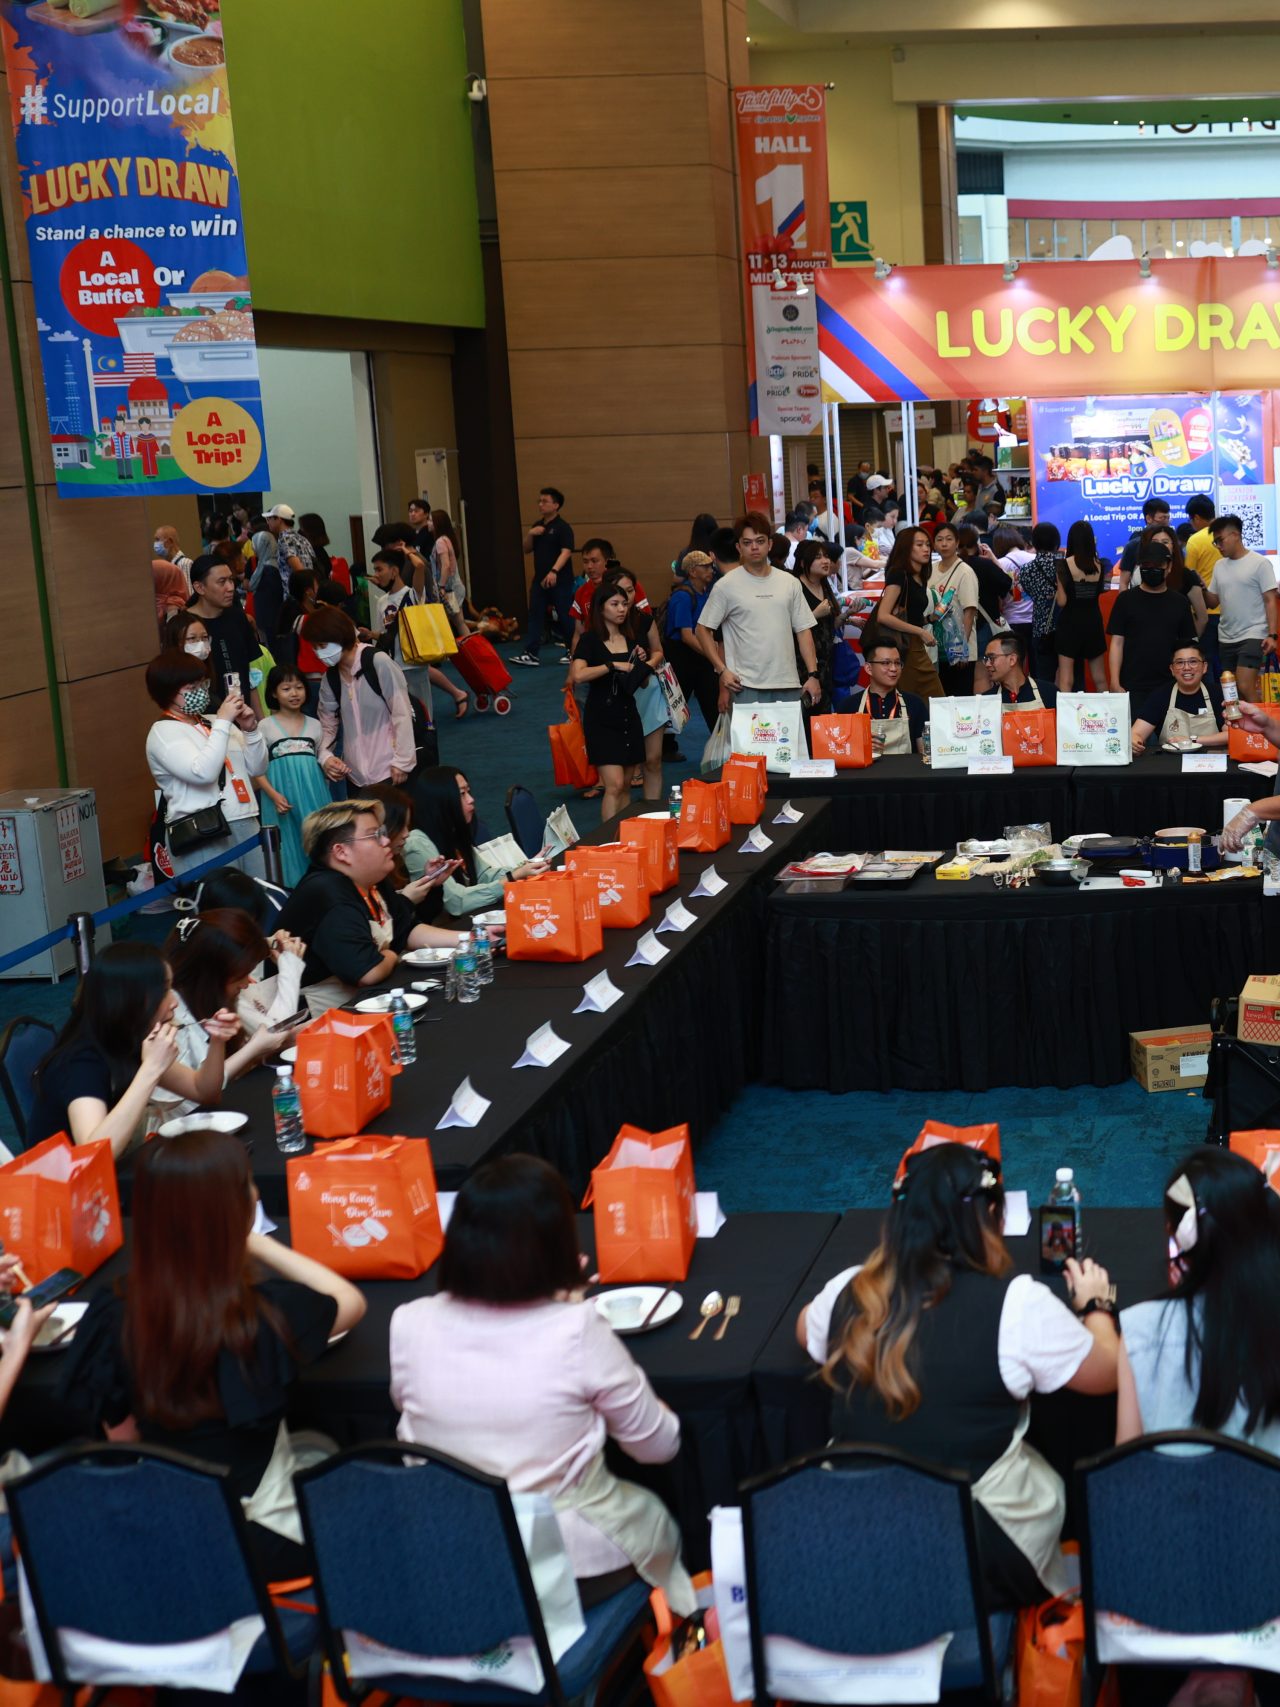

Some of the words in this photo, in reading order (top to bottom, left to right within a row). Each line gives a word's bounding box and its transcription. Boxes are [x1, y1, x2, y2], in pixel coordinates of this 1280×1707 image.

[20, 86, 219, 124] #SupportLocal
[755, 136, 812, 154] HALL
[30, 157, 130, 215] LUCKY
[137, 157, 230, 208] DRAW
[755, 164, 808, 249] 1
[35, 226, 86, 241] Stand
[89, 228, 100, 240] a
[103, 223, 167, 240] chance
[169, 223, 187, 238] to
[190, 215, 238, 238] win
[99, 251, 116, 268] A
[748, 254, 763, 270] 11
[770, 254, 788, 270] 13
[791, 260, 828, 269] AUGUST
[79, 270, 140, 286] Local
[153, 266, 185, 287] Or
[78, 288, 146, 306] Buffet
[936, 304, 1137, 358] LUCKY
[206, 411, 222, 427] A
[186, 430, 246, 447] Local
[193, 448, 243, 466] Trip!
[1083, 476, 1150, 498] Lucky
[1152, 476, 1214, 495] Draw
[1091, 513, 1111, 521] Local
[1111, 513, 1126, 523] Trip
[1127, 513, 1139, 521] OR
[321, 1192, 348, 1206] Hong
[350, 1192, 377, 1206] Kong
[344, 1208, 370, 1218] Dim
[370, 1208, 393, 1218] Sum
